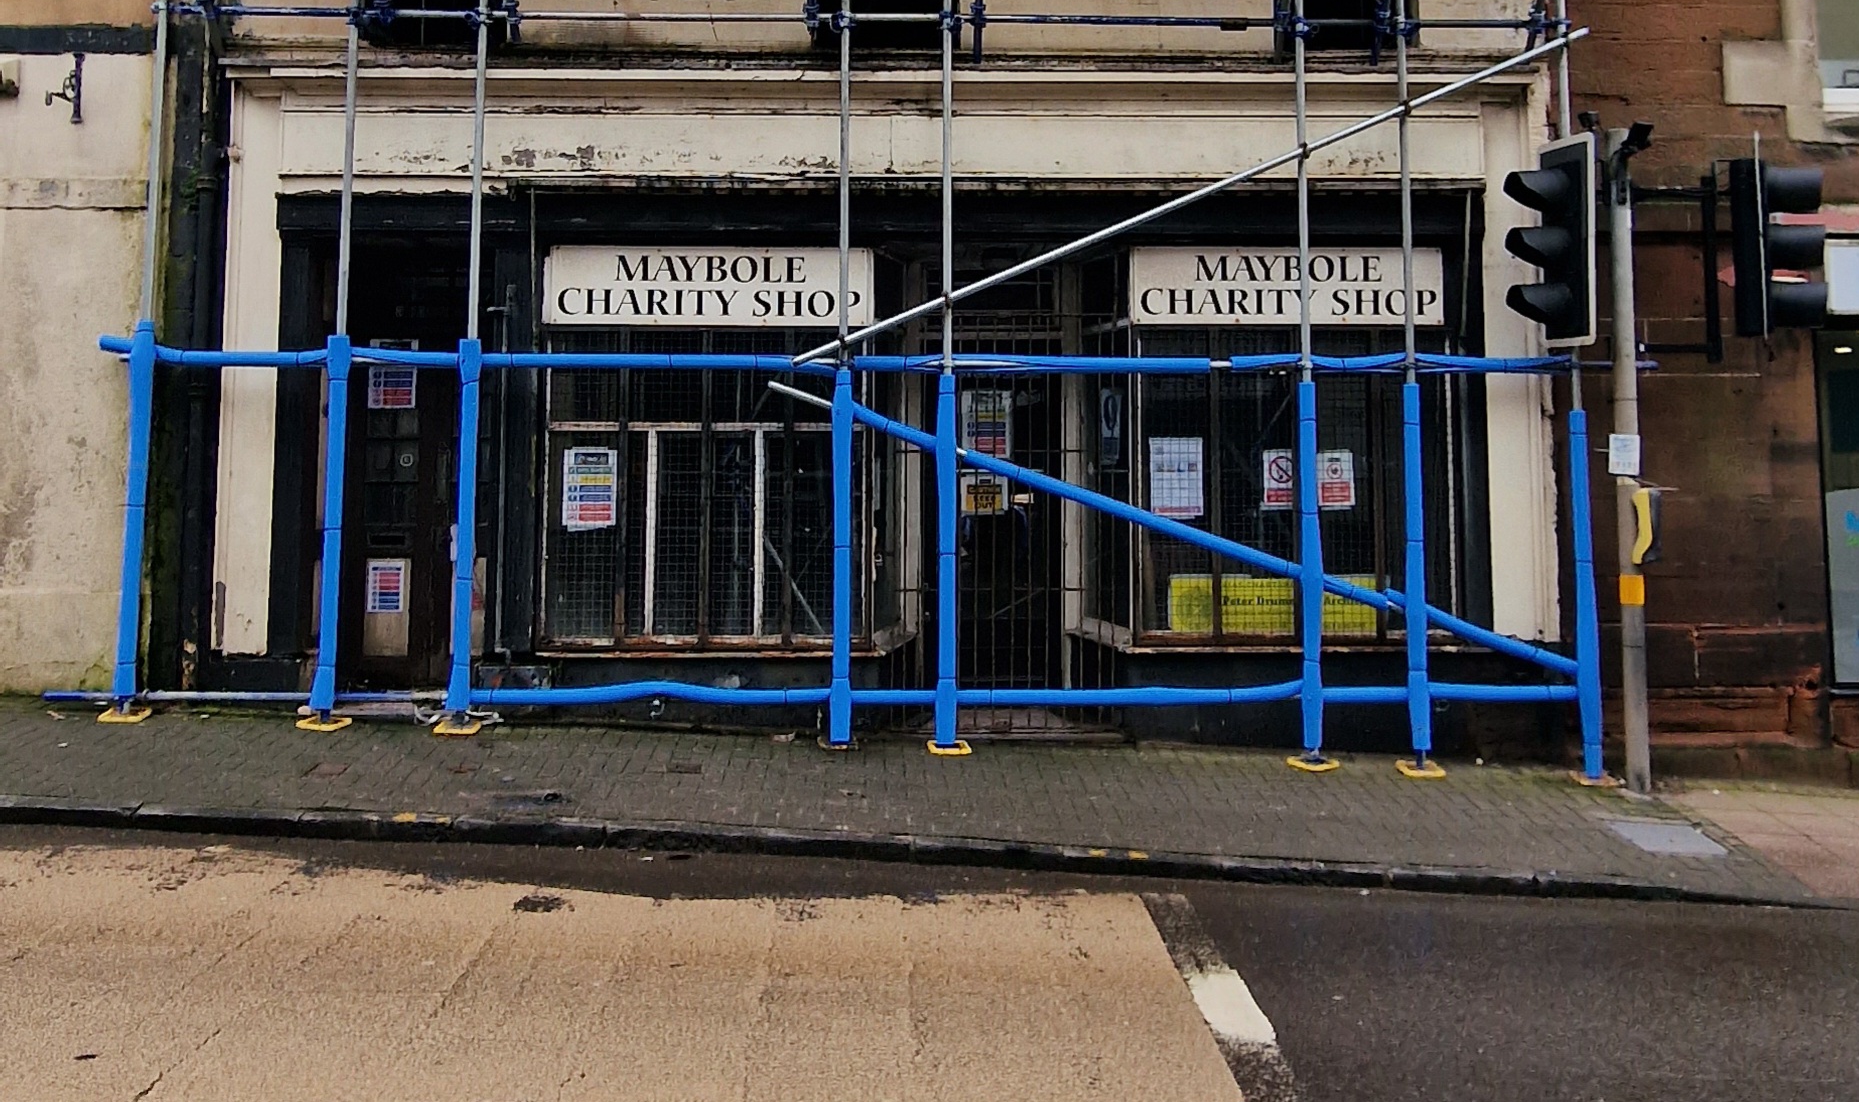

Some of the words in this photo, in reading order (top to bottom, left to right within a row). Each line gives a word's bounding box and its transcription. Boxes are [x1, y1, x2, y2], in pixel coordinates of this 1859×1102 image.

[614, 255, 806, 283] MAYBOLE
[1195, 255, 1383, 282] MAYBOLE
[557, 287, 740, 316] CHARITY
[752, 289, 861, 317] SHOP
[1331, 289, 1437, 316] SHOP
[1222, 595, 1254, 606] Peter
